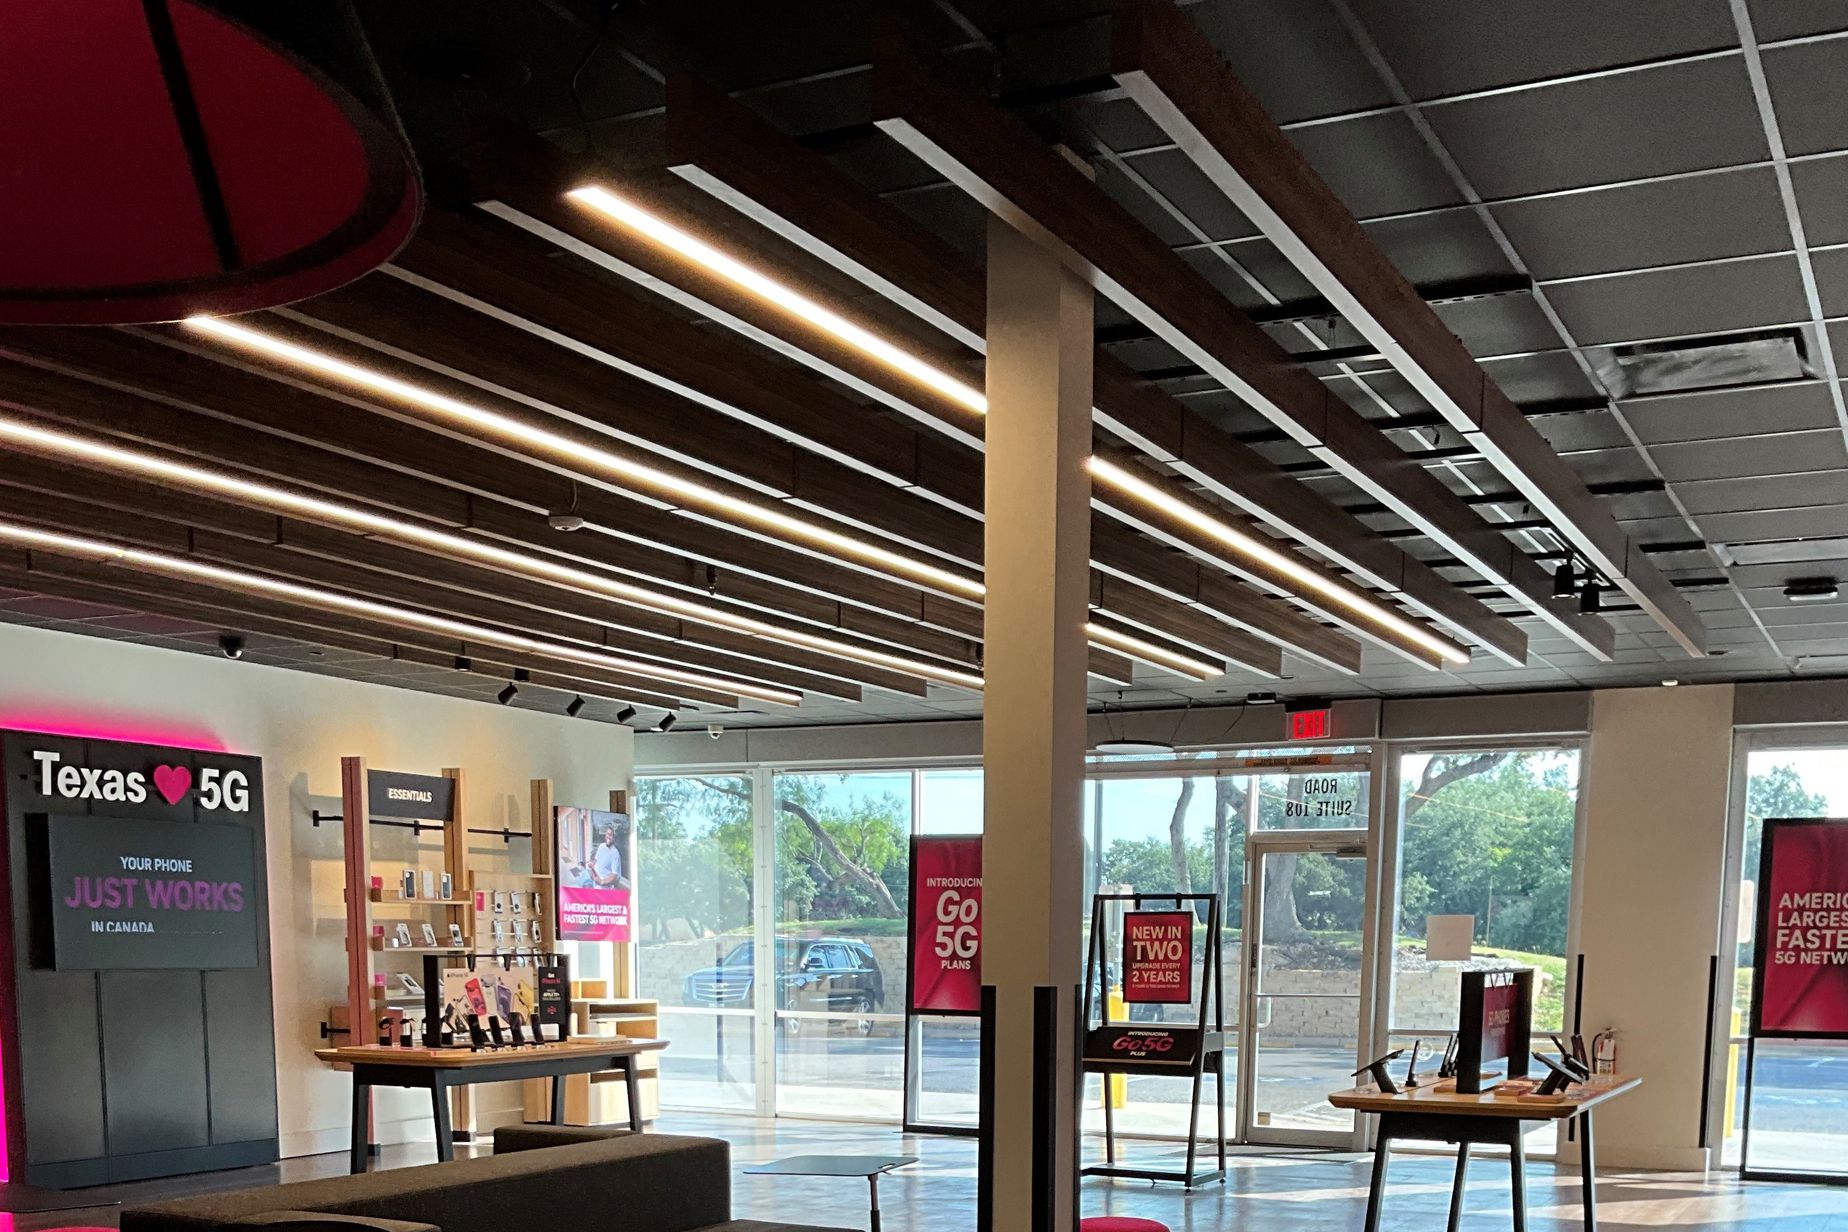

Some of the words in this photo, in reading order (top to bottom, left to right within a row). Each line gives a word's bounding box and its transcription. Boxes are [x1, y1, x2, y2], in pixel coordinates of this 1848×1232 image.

[1293, 710, 1325, 738] EXIT
[33, 751, 147, 803] Texas
[200, 768, 249, 812] 5G
[388, 788, 433, 803] ESSENTIALS
[120, 856, 152, 871] YOUR
[154, 858, 193, 873] PHONE
[64, 876, 139, 909] JUST
[144, 878, 245, 913] WORKS
[936, 889, 979, 924] Go
[91, 920, 104, 933] IN
[106, 921, 155, 933] CANADA
[1777, 911, 1848, 928] LARGES
[1132, 926, 1165, 939] NEW
[1167, 926, 1182, 939] IN
[1776, 929, 1848, 949] FASTE
[934, 925, 979, 959] 5G
[1132, 940, 1183, 961] TWO
[941, 960, 972, 970] PLANS
[1774, 951, 1796, 965] 5G
[1800, 951, 1848, 965] NETW
[1132, 970, 1140, 983] 2
[1142, 971, 1181, 983] YEARS
